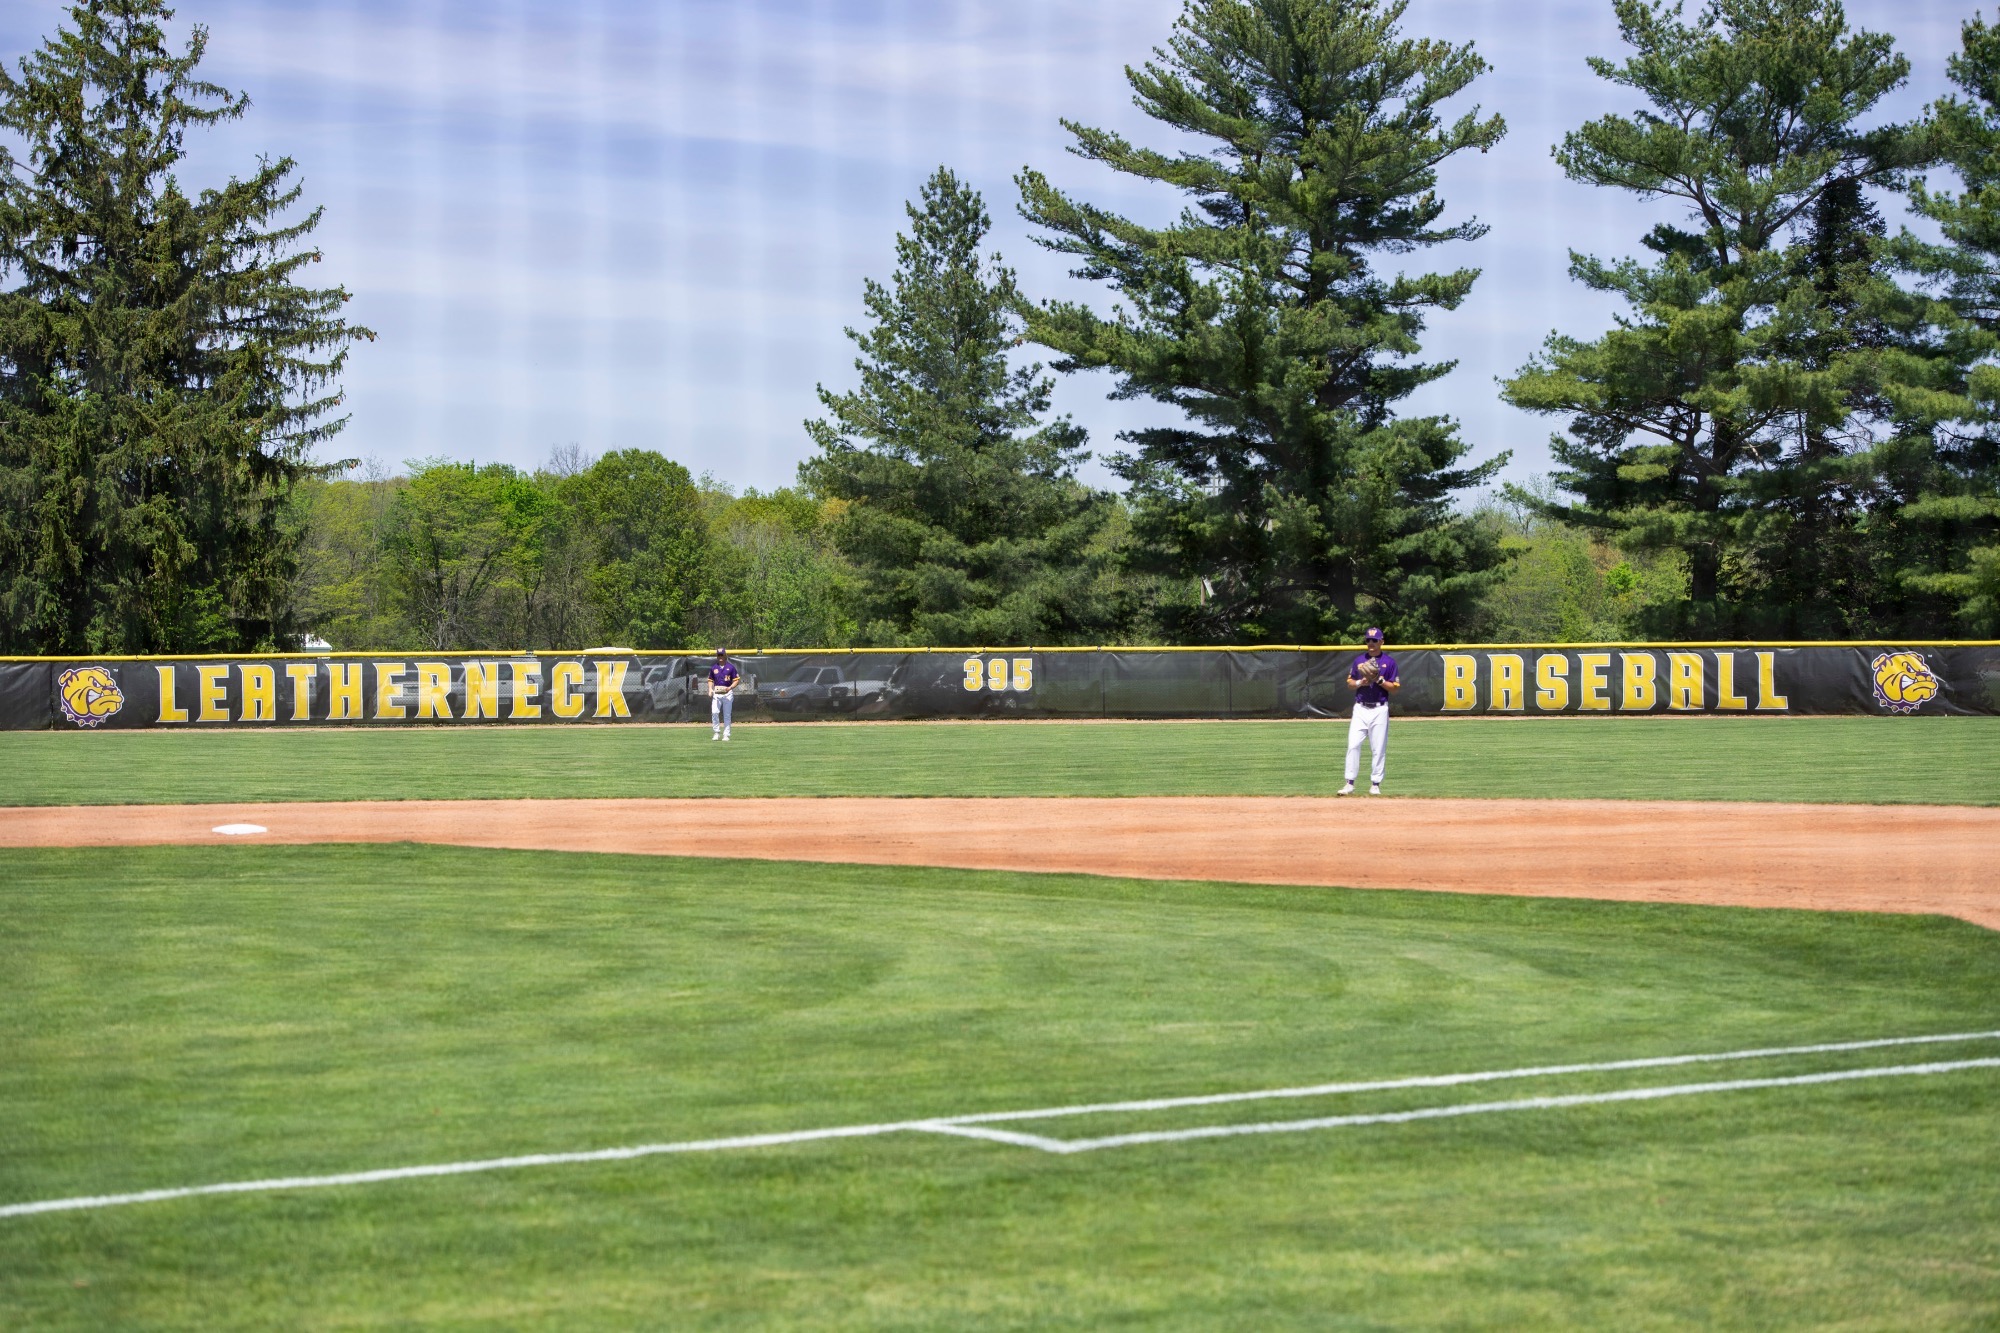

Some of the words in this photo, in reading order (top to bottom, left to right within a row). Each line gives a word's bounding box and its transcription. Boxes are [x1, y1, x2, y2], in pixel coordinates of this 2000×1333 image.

[155, 660, 632, 722] LEATHERNECK
[963, 657, 1033, 692] 395
[1441, 651, 1789, 711] BASEBALL
